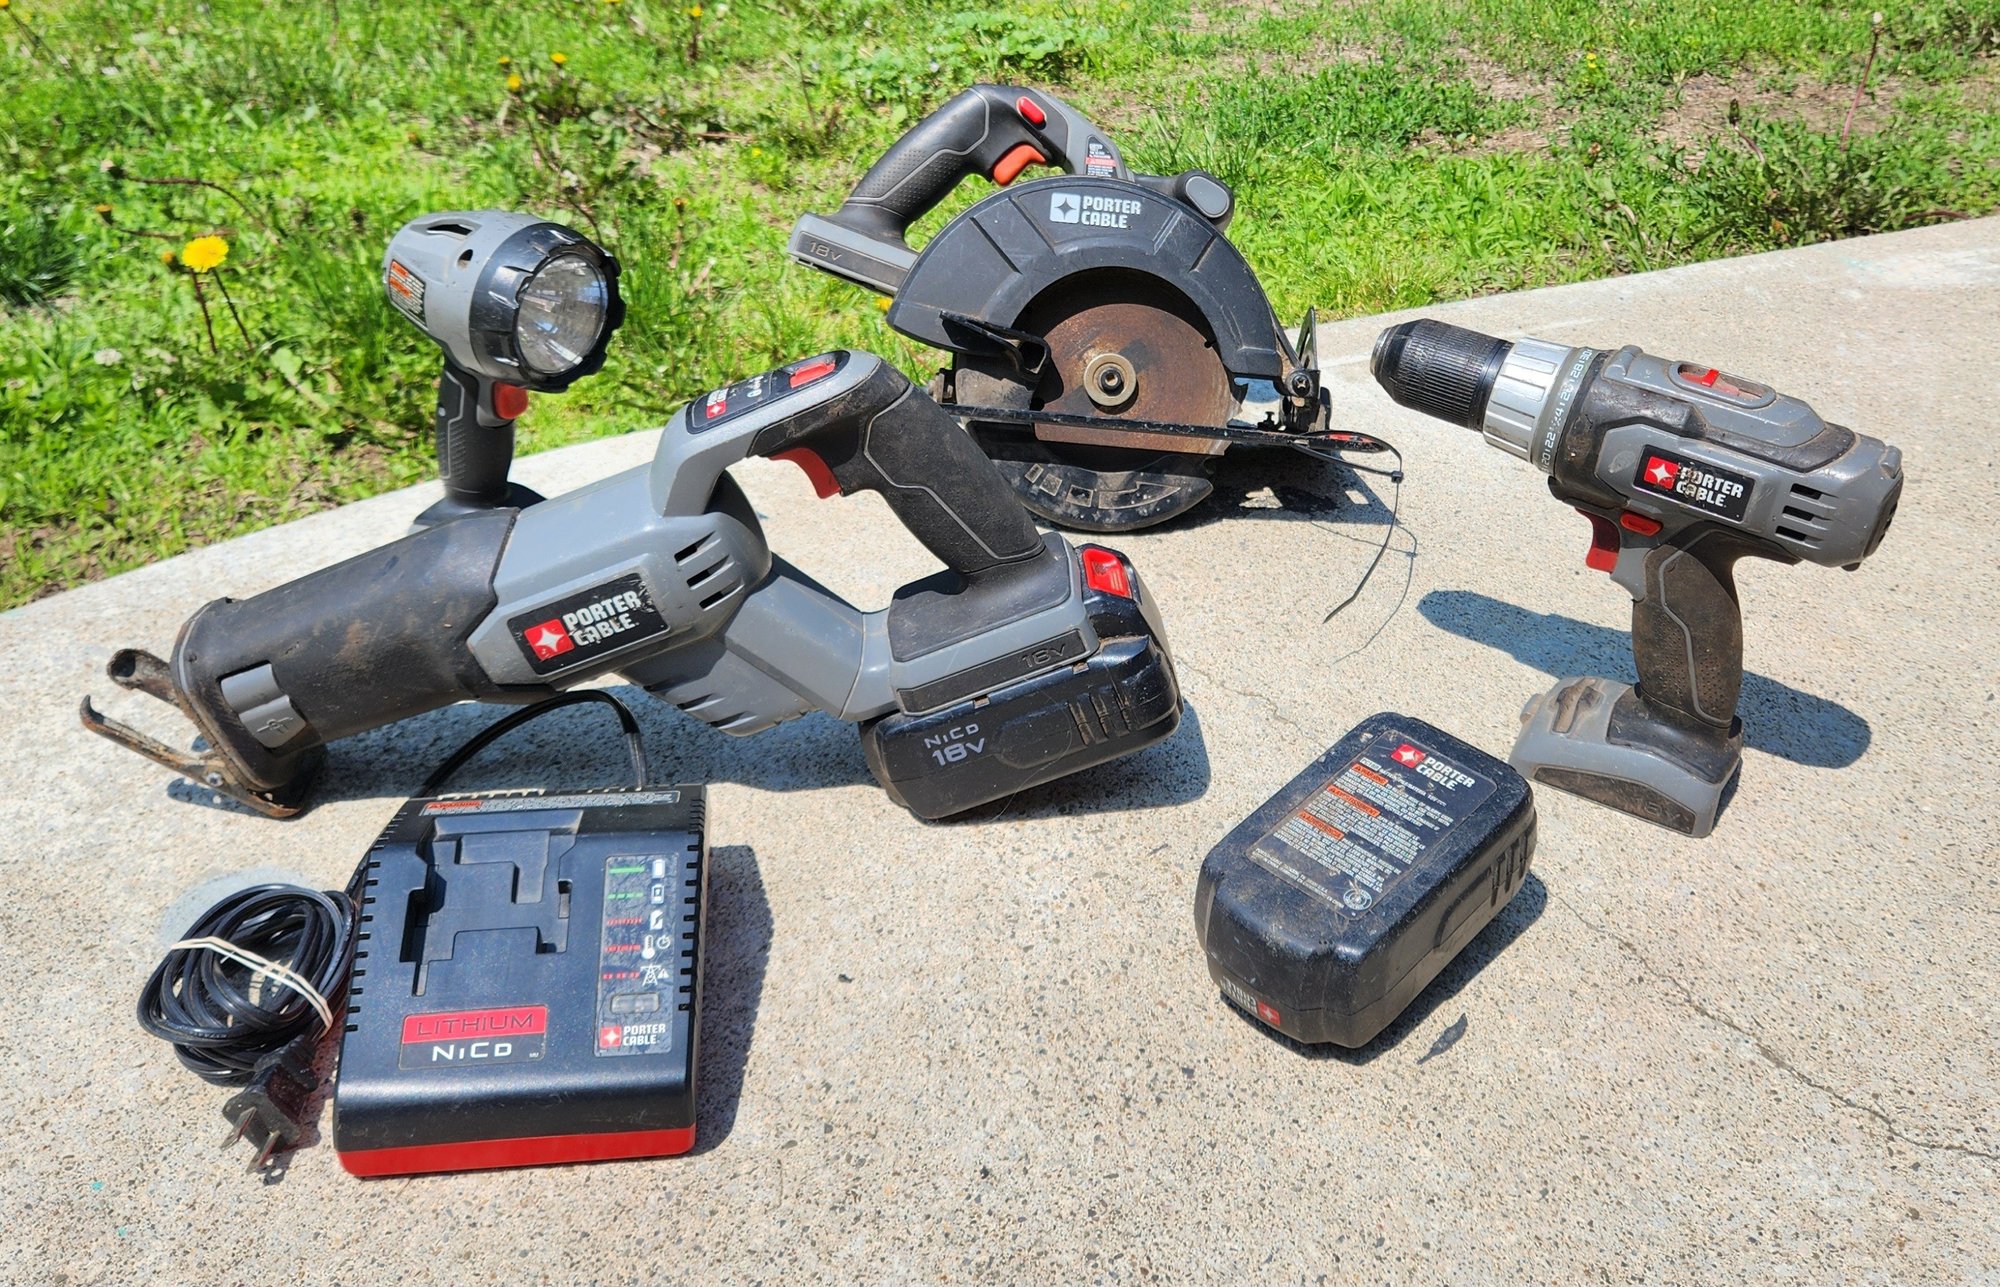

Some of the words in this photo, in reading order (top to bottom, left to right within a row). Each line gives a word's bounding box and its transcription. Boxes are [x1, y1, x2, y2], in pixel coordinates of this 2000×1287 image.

[1082, 195, 1141, 214] PORTER
[1081, 210, 1129, 229] CABLE
[809, 240, 842, 261] 18V
[1545, 432, 1556, 449] 22
[1570, 363, 1584, 378] 28
[1676, 480, 1726, 507] CABLE
[1680, 465, 1744, 498] PORTER
[562, 590, 641, 631] PORTER
[567, 612, 635, 646] CABLE
[932, 737, 985, 766] 18V
[1415, 764, 1458, 790] CABLE
[1423, 756, 1475, 788] PORTER
[417, 1013, 533, 1036] LITHIUM
[623, 1023, 666, 1036] PORTER
[622, 1034, 657, 1046] CABLE
